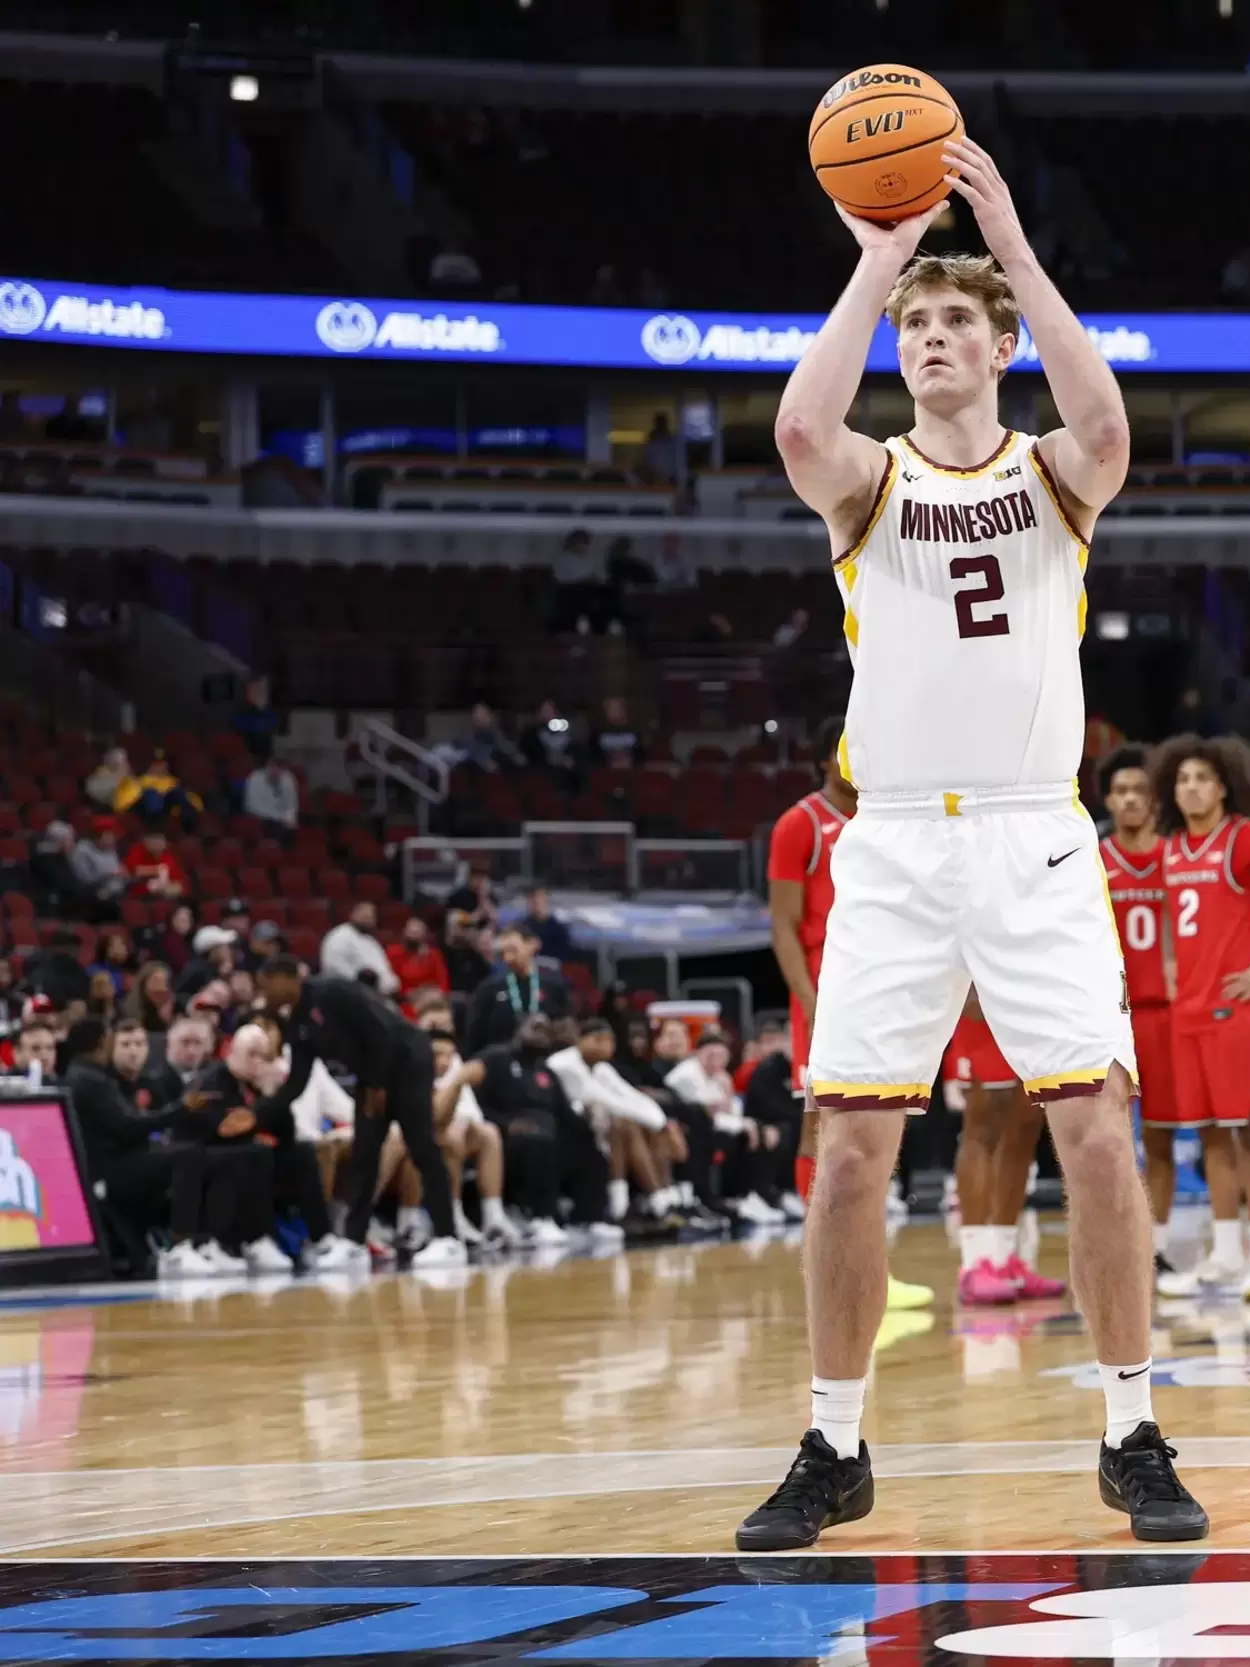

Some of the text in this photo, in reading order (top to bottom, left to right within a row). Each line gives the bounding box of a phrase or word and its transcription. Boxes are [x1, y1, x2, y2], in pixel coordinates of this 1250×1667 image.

[823, 72, 921, 108] Wilson
[846, 111, 905, 144] EVO
[43, 294, 166, 340] Allstate
[374, 312, 501, 353] Allstate
[900, 489, 1039, 543] MINNESOTA
[949, 554, 1010, 639] 2
[1126, 905, 1156, 951] 0
[1177, 888, 1200, 938] 2
